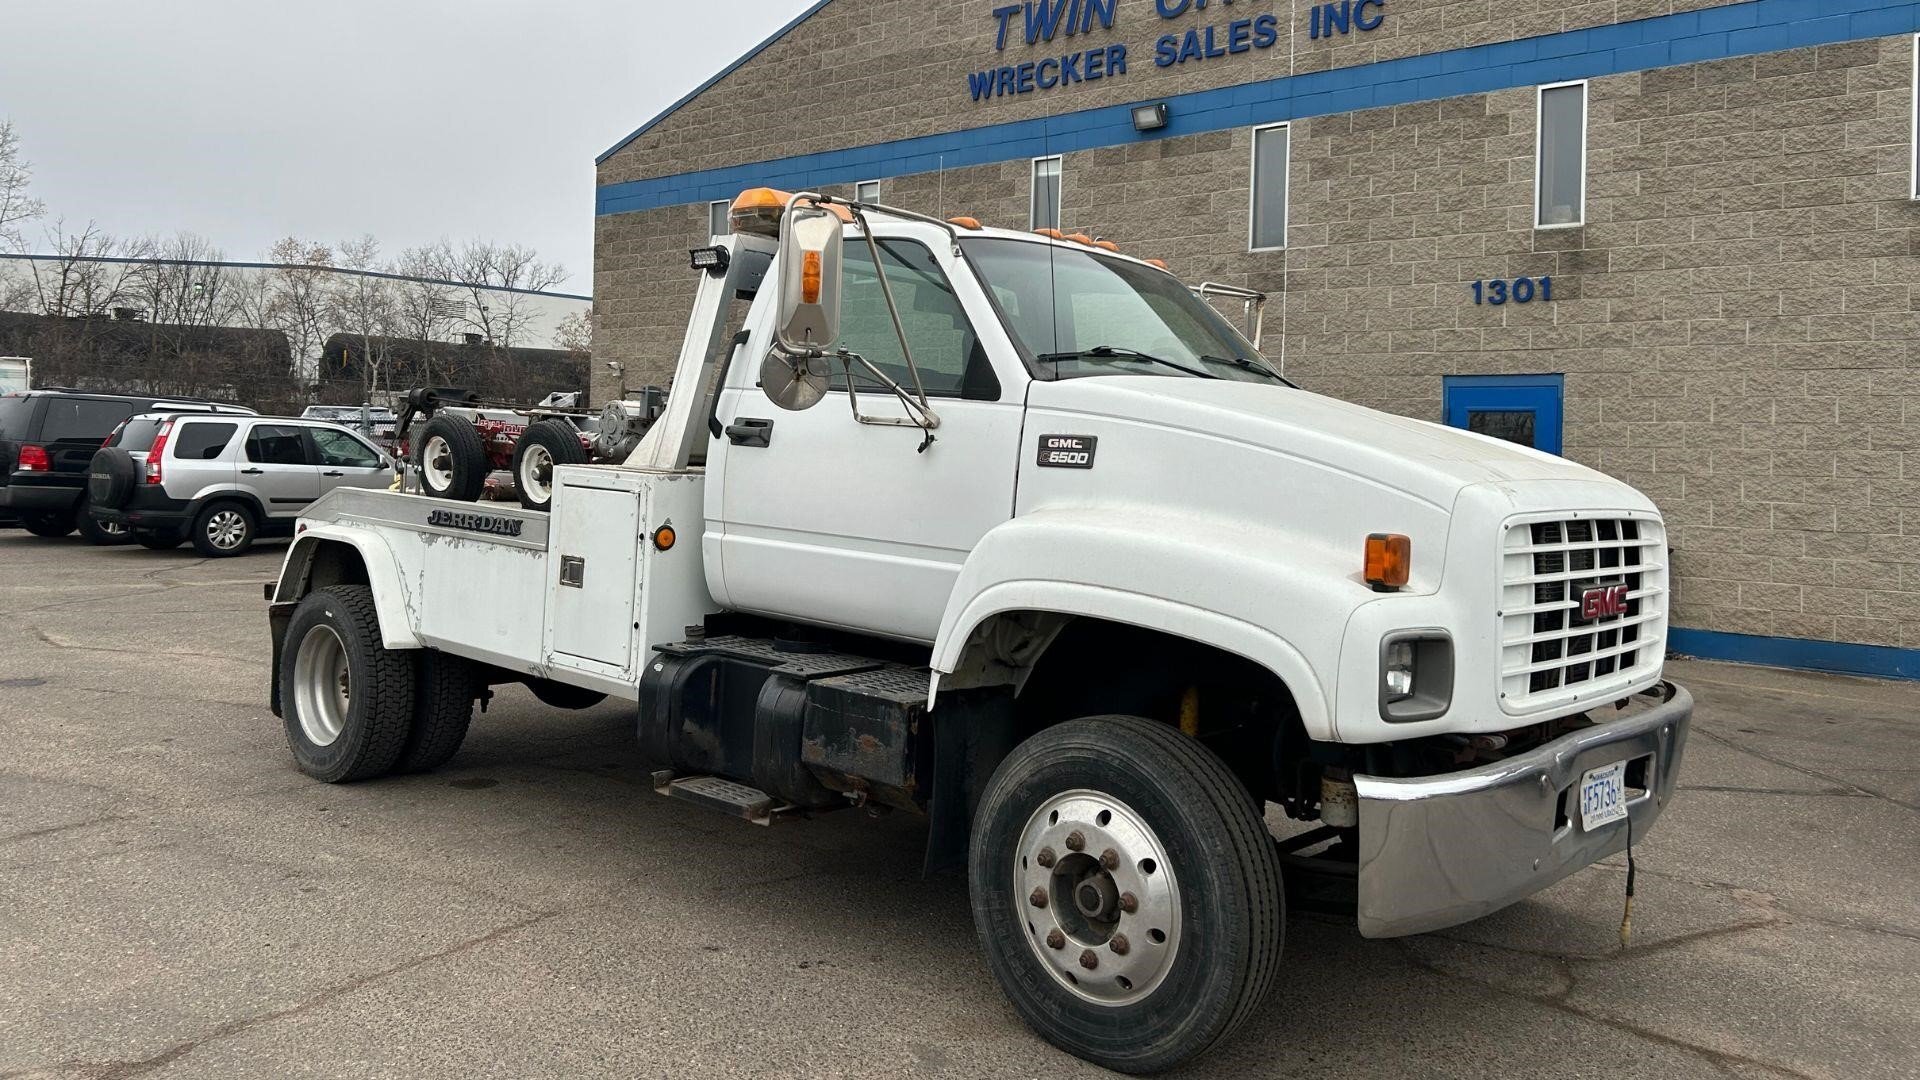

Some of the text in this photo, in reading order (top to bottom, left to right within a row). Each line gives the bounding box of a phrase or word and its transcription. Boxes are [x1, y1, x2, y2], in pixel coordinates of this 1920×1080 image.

[992, 0, 1120, 50] TWIN
[968, 0, 1384, 100] WRECKER SALES INC
[1471, 276, 1551, 305] 1301
[1047, 438, 1083, 449] GMC
[1582, 584, 1628, 619] GMC
